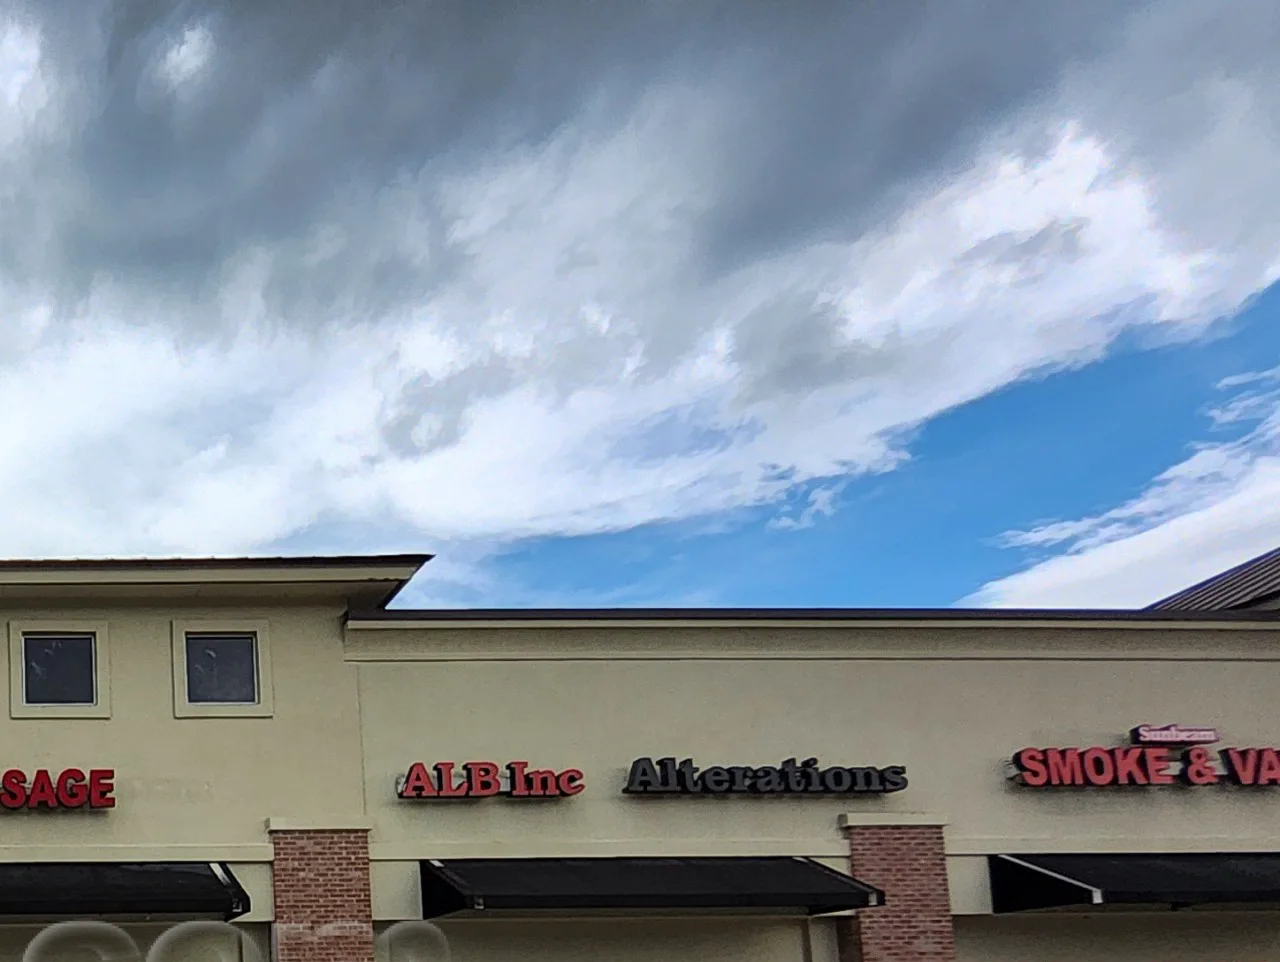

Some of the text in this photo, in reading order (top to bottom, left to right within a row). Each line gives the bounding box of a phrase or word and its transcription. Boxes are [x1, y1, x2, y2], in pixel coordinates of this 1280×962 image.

[400, 761, 586, 798] ALB Inc
[622, 757, 909, 797] Alterations
[1018, 747, 1176, 786] SMOKE
[1187, 747, 1218, 785] &
